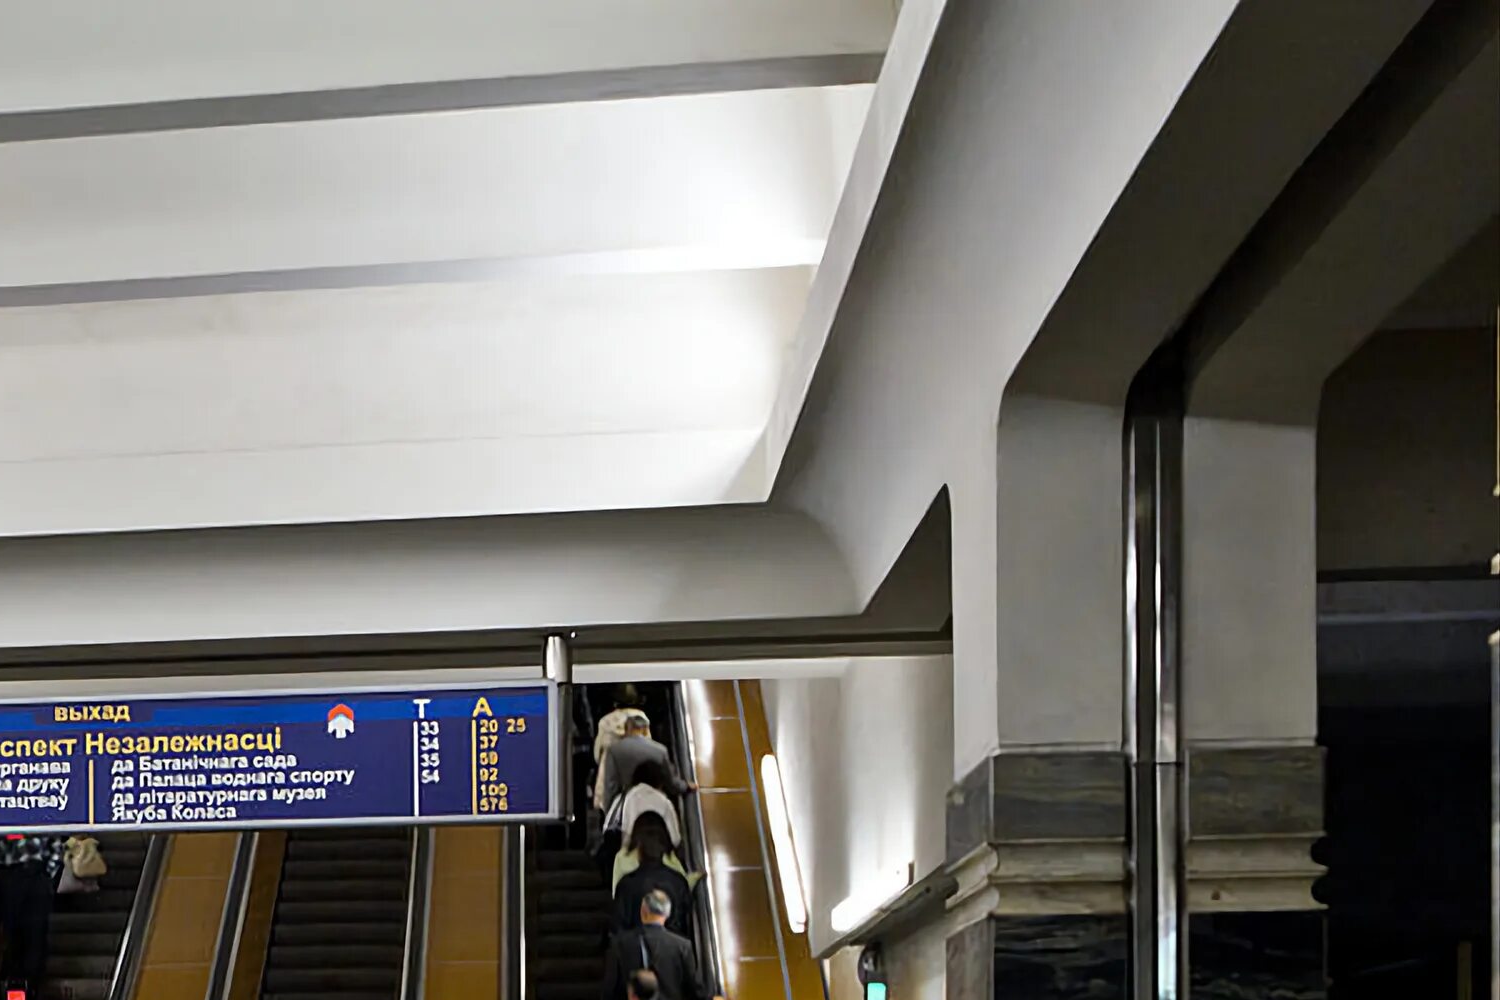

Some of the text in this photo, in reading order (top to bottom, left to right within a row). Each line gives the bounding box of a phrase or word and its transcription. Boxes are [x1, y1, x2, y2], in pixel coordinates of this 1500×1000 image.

[54, 705, 130, 723] выхад
[85, 727, 282, 756] Незалежнасці
[111, 758, 135, 775] да
[139, 755, 248, 771] Батанічнага
[111, 775, 135, 791] да
[211, 771, 286, 788] воднага
[290, 769, 355, 786] спорту
[111, 791, 135, 807] да
[111, 804, 237, 824] Якуба Коласа
